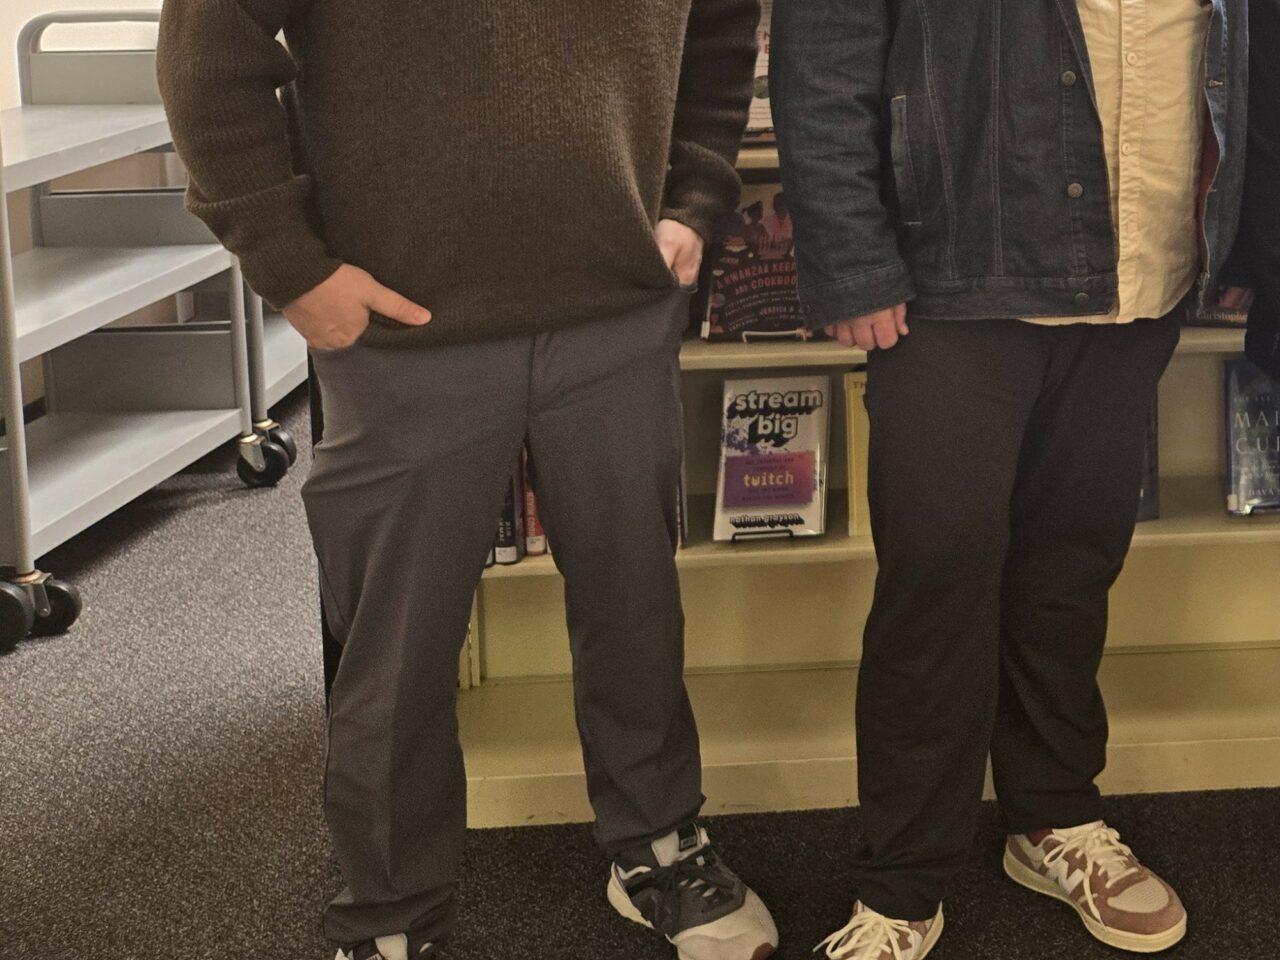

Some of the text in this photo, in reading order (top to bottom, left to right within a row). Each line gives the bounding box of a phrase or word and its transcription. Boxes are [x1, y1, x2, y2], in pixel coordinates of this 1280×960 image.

[723, 263, 769, 285] KWANZAA
[735, 389, 822, 411] stream
[757, 415, 799, 440] big
[743, 470, 794, 487] twitch
[729, 512, 801, 525] nathan grayson
